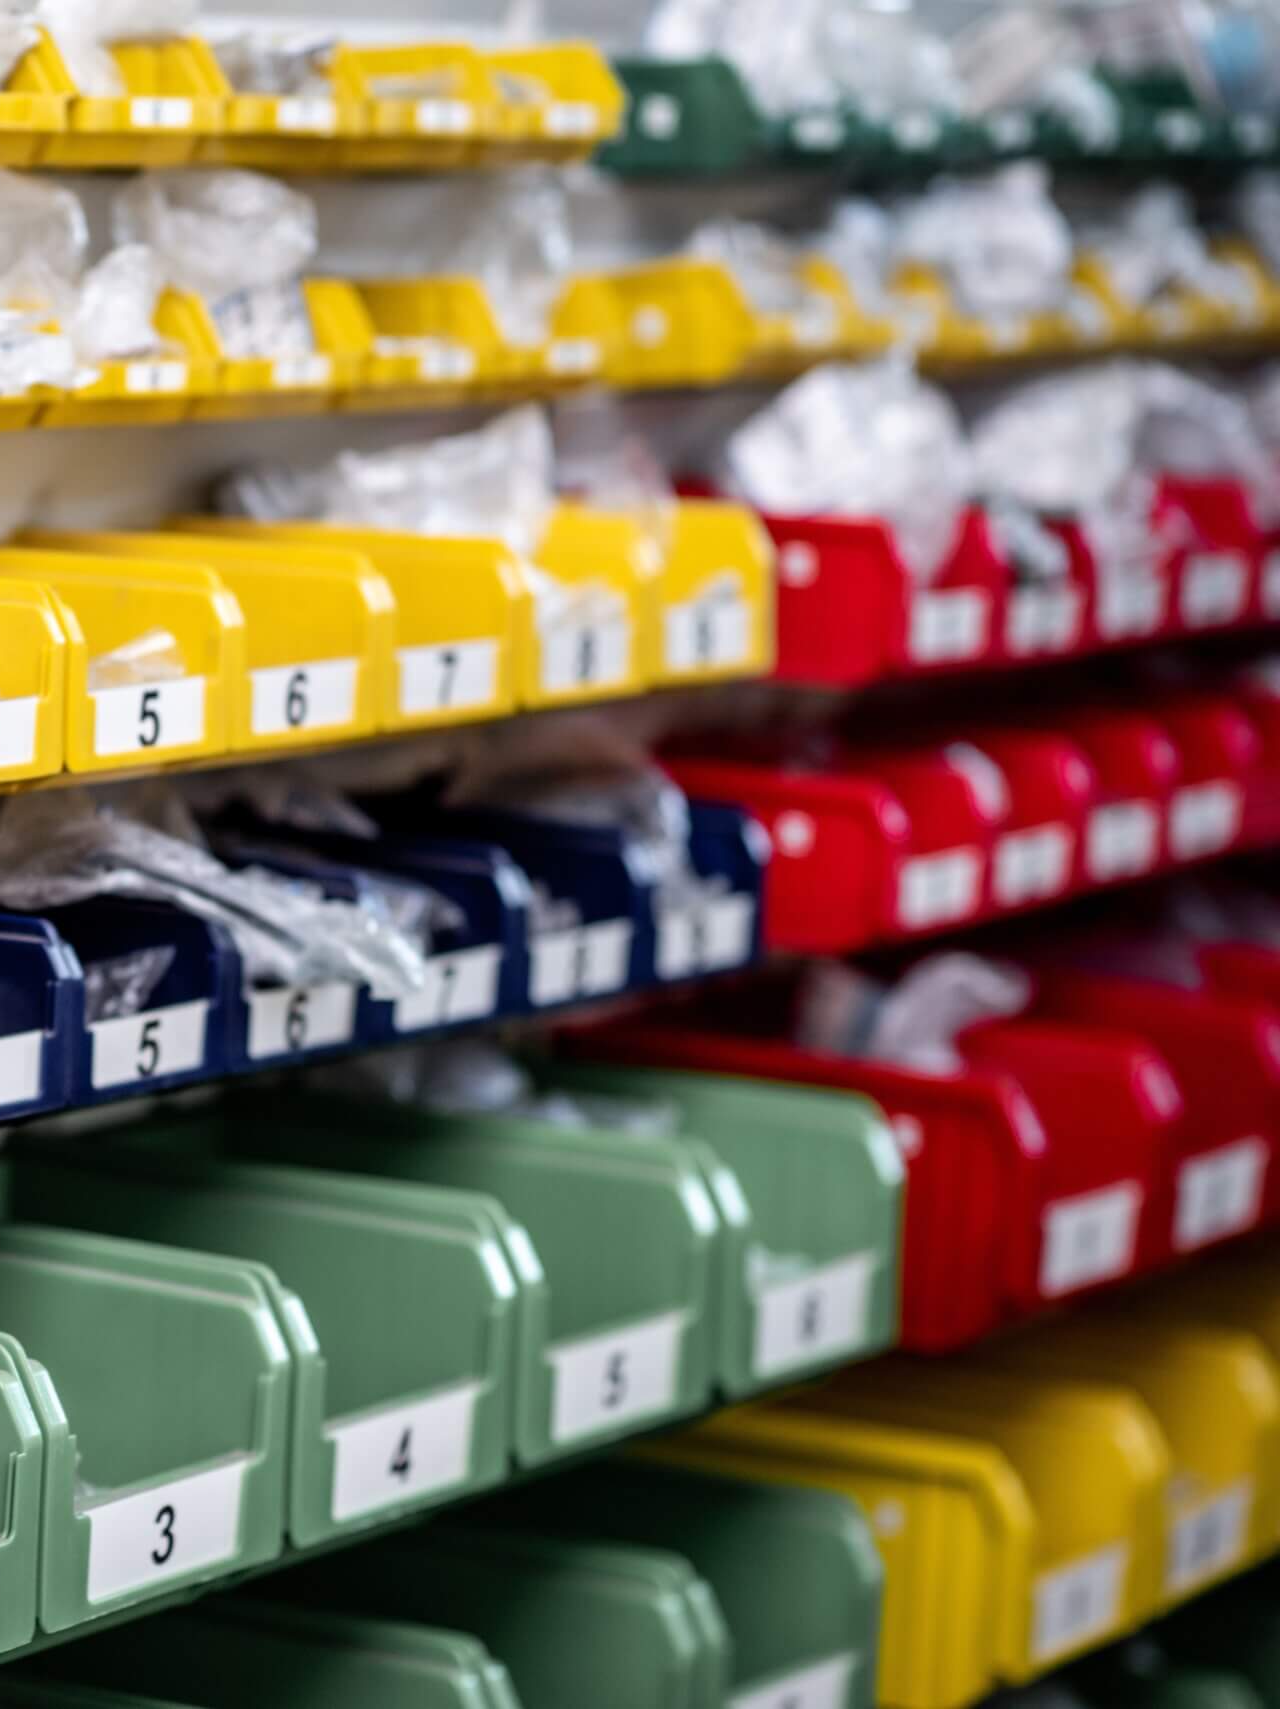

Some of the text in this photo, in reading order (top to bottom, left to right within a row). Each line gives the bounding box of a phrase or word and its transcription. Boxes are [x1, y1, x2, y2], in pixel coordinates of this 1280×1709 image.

[285, 672, 308, 729] 6
[439, 650, 459, 706] 7
[138, 690, 161, 748] 5
[137, 1019, 161, 1077] 5
[286, 989, 308, 1050] 6
[603, 1353, 626, 1409] 5
[388, 1428, 412, 1483] 4
[151, 1504, 175, 1566] 3
